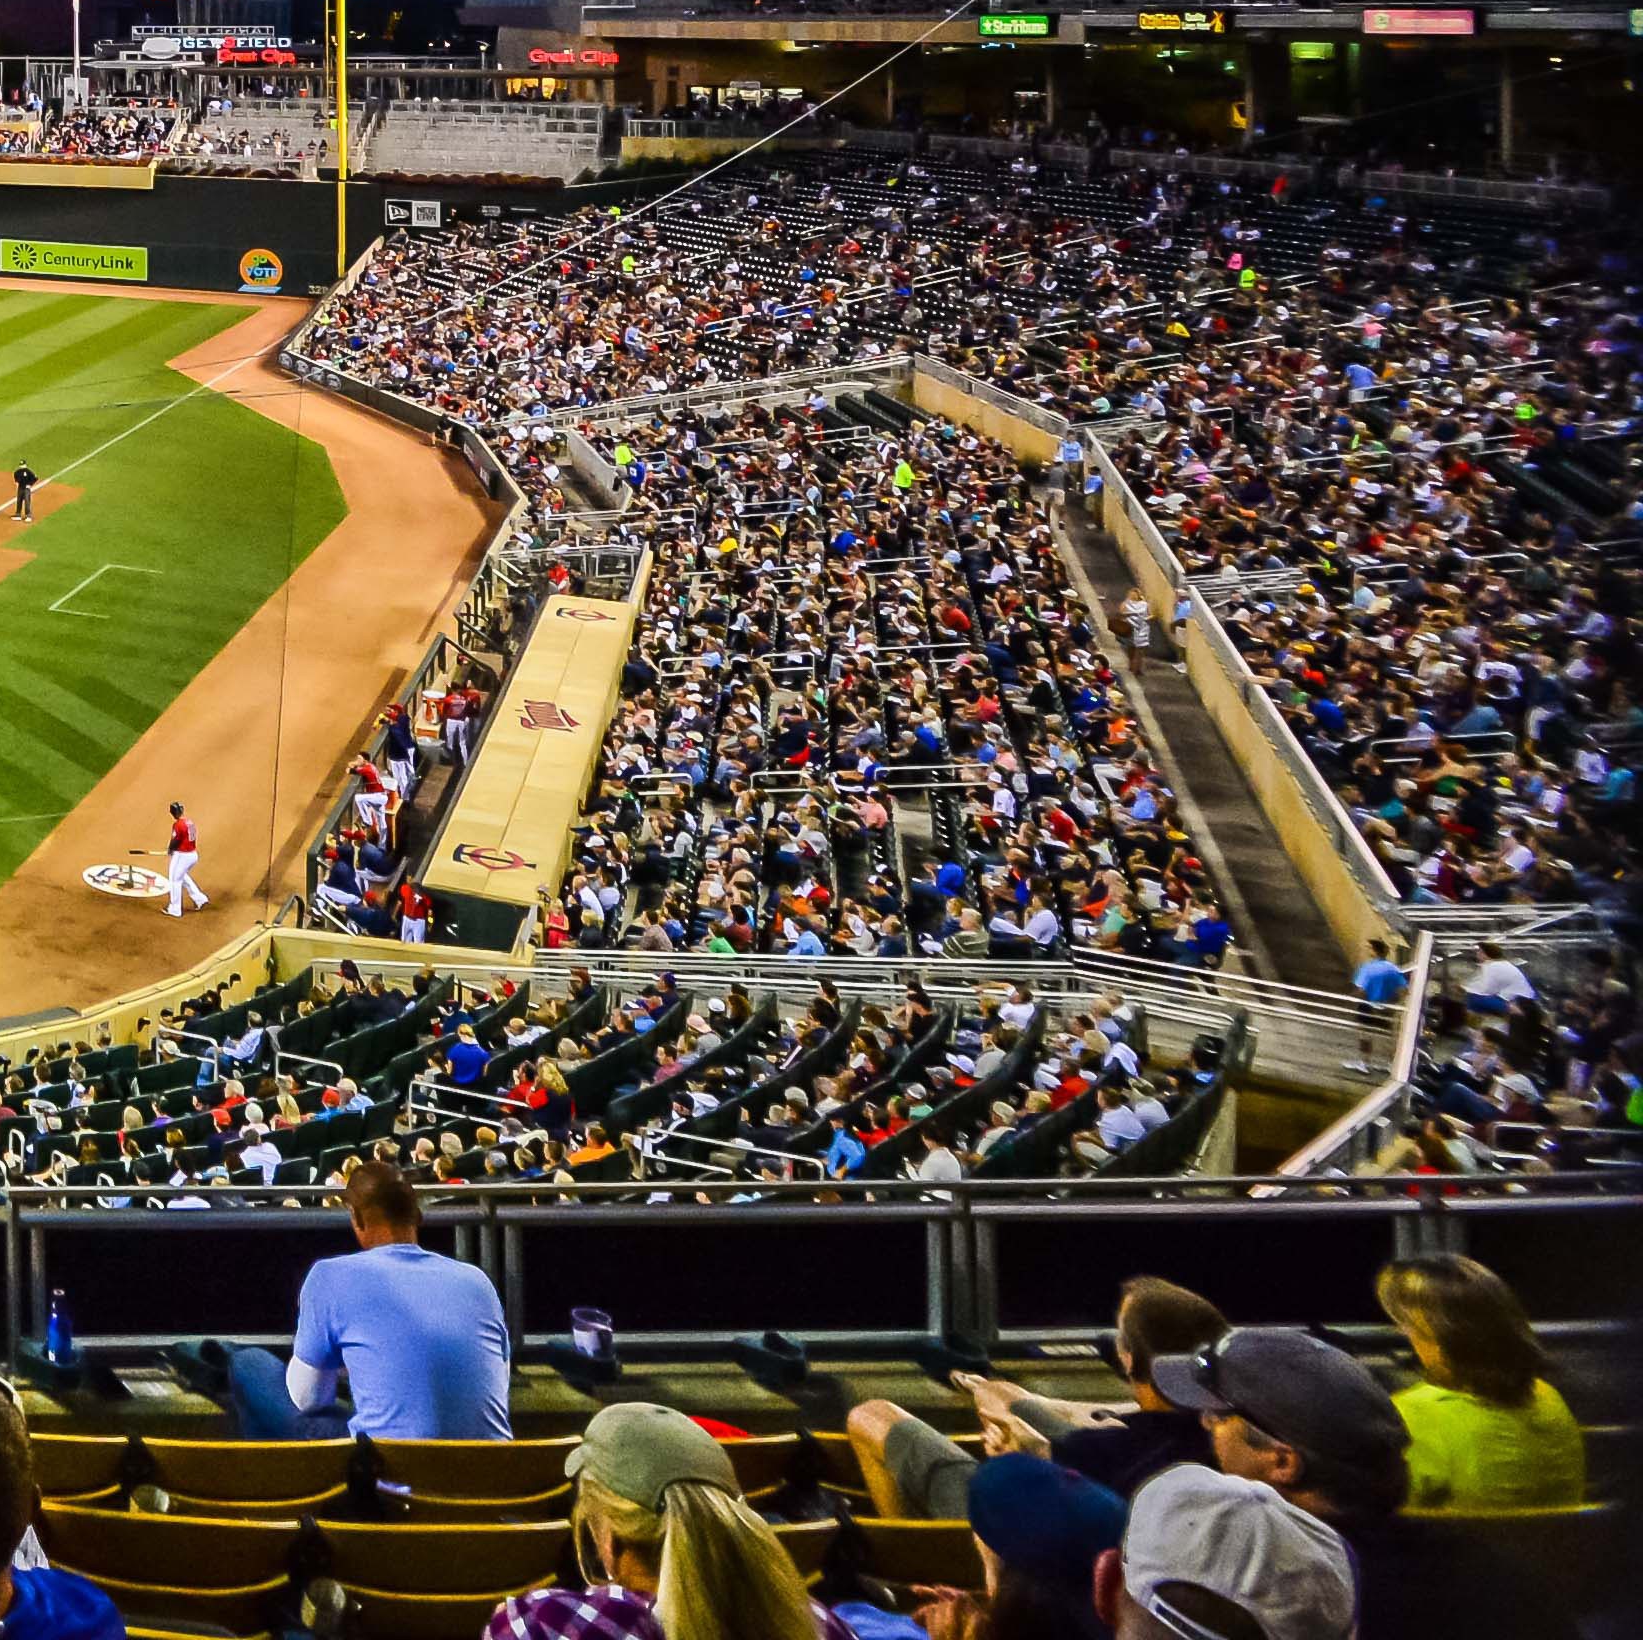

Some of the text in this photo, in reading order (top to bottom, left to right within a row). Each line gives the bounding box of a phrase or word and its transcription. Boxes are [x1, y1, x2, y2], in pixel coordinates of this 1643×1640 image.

[236, 37, 292, 49] FIELD
[43, 251, 135, 271] CenturyLink
[245, 266, 279, 279] VOTE
